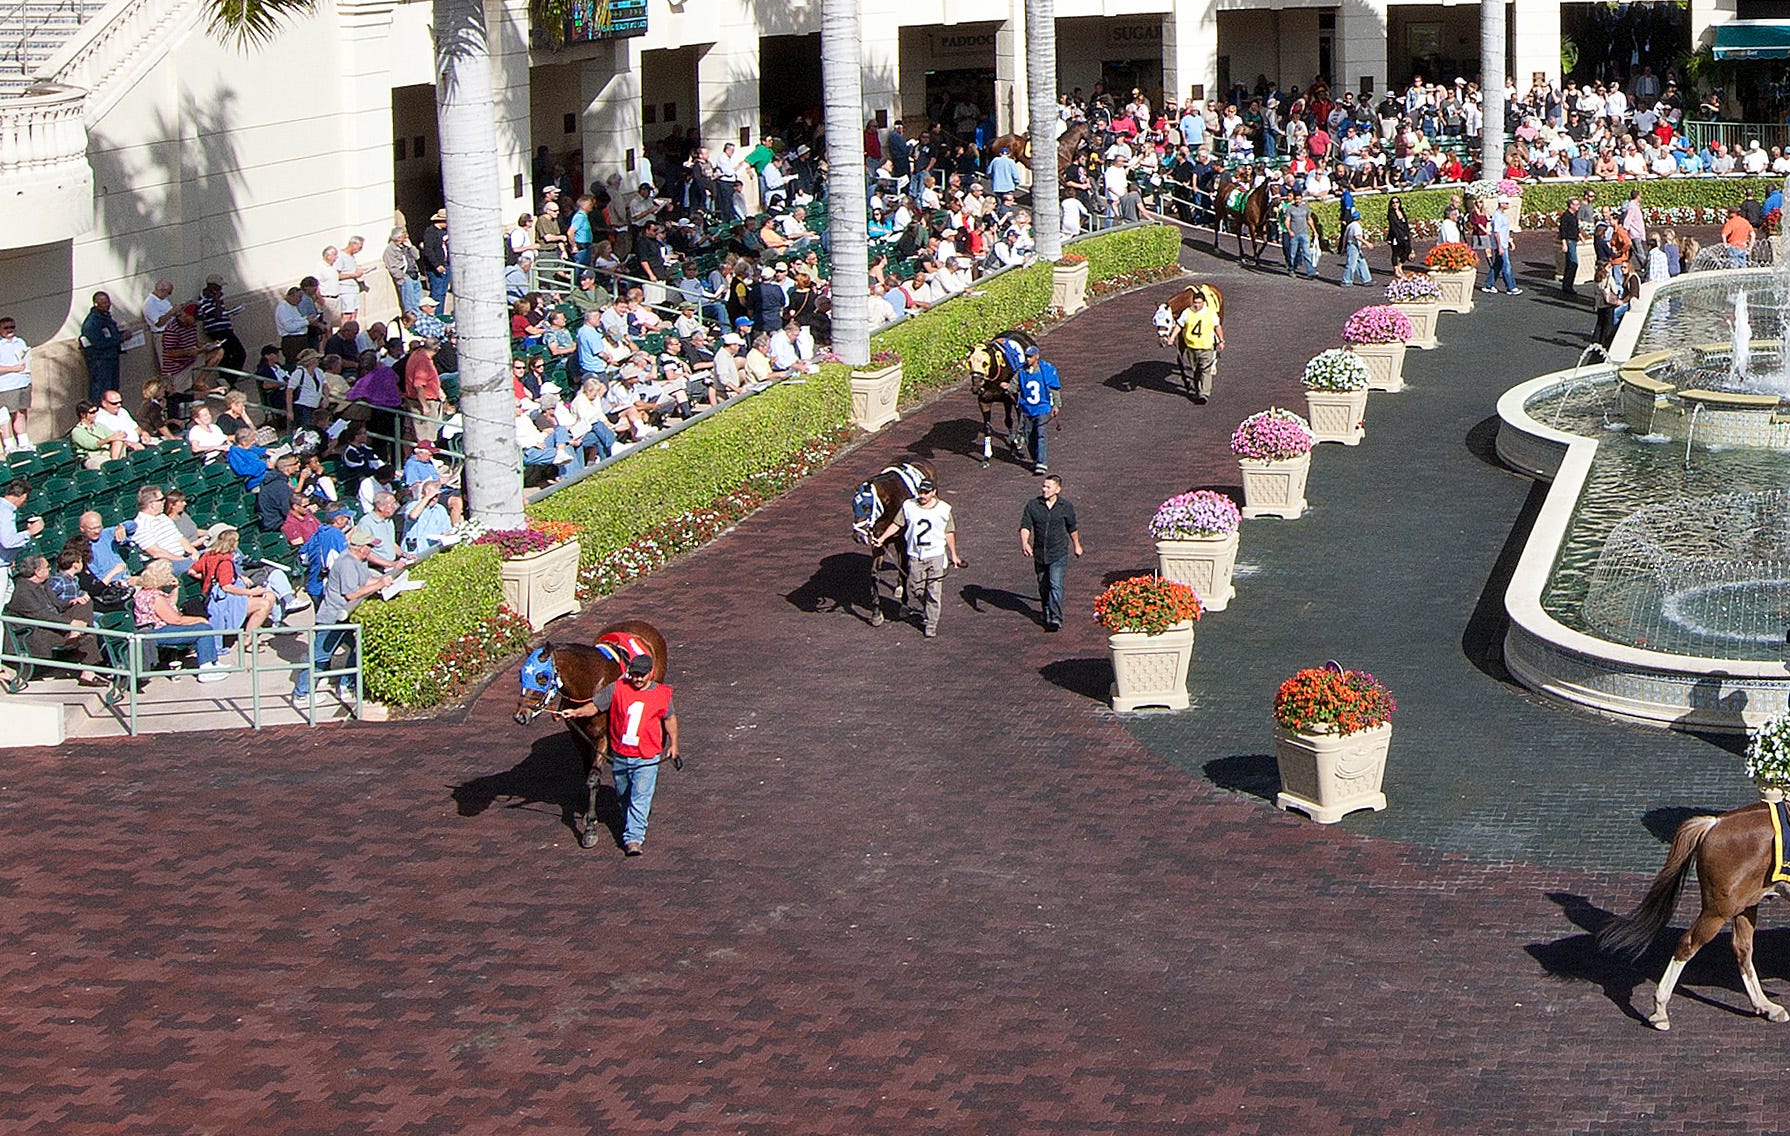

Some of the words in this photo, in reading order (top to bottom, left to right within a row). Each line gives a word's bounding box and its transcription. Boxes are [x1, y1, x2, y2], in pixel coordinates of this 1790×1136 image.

[941, 34, 995, 48] PADDOC
[1190, 319, 1203, 339] 4
[1025, 380, 1041, 405] 3
[916, 518, 932, 546] 2
[622, 701, 645, 746] 1
